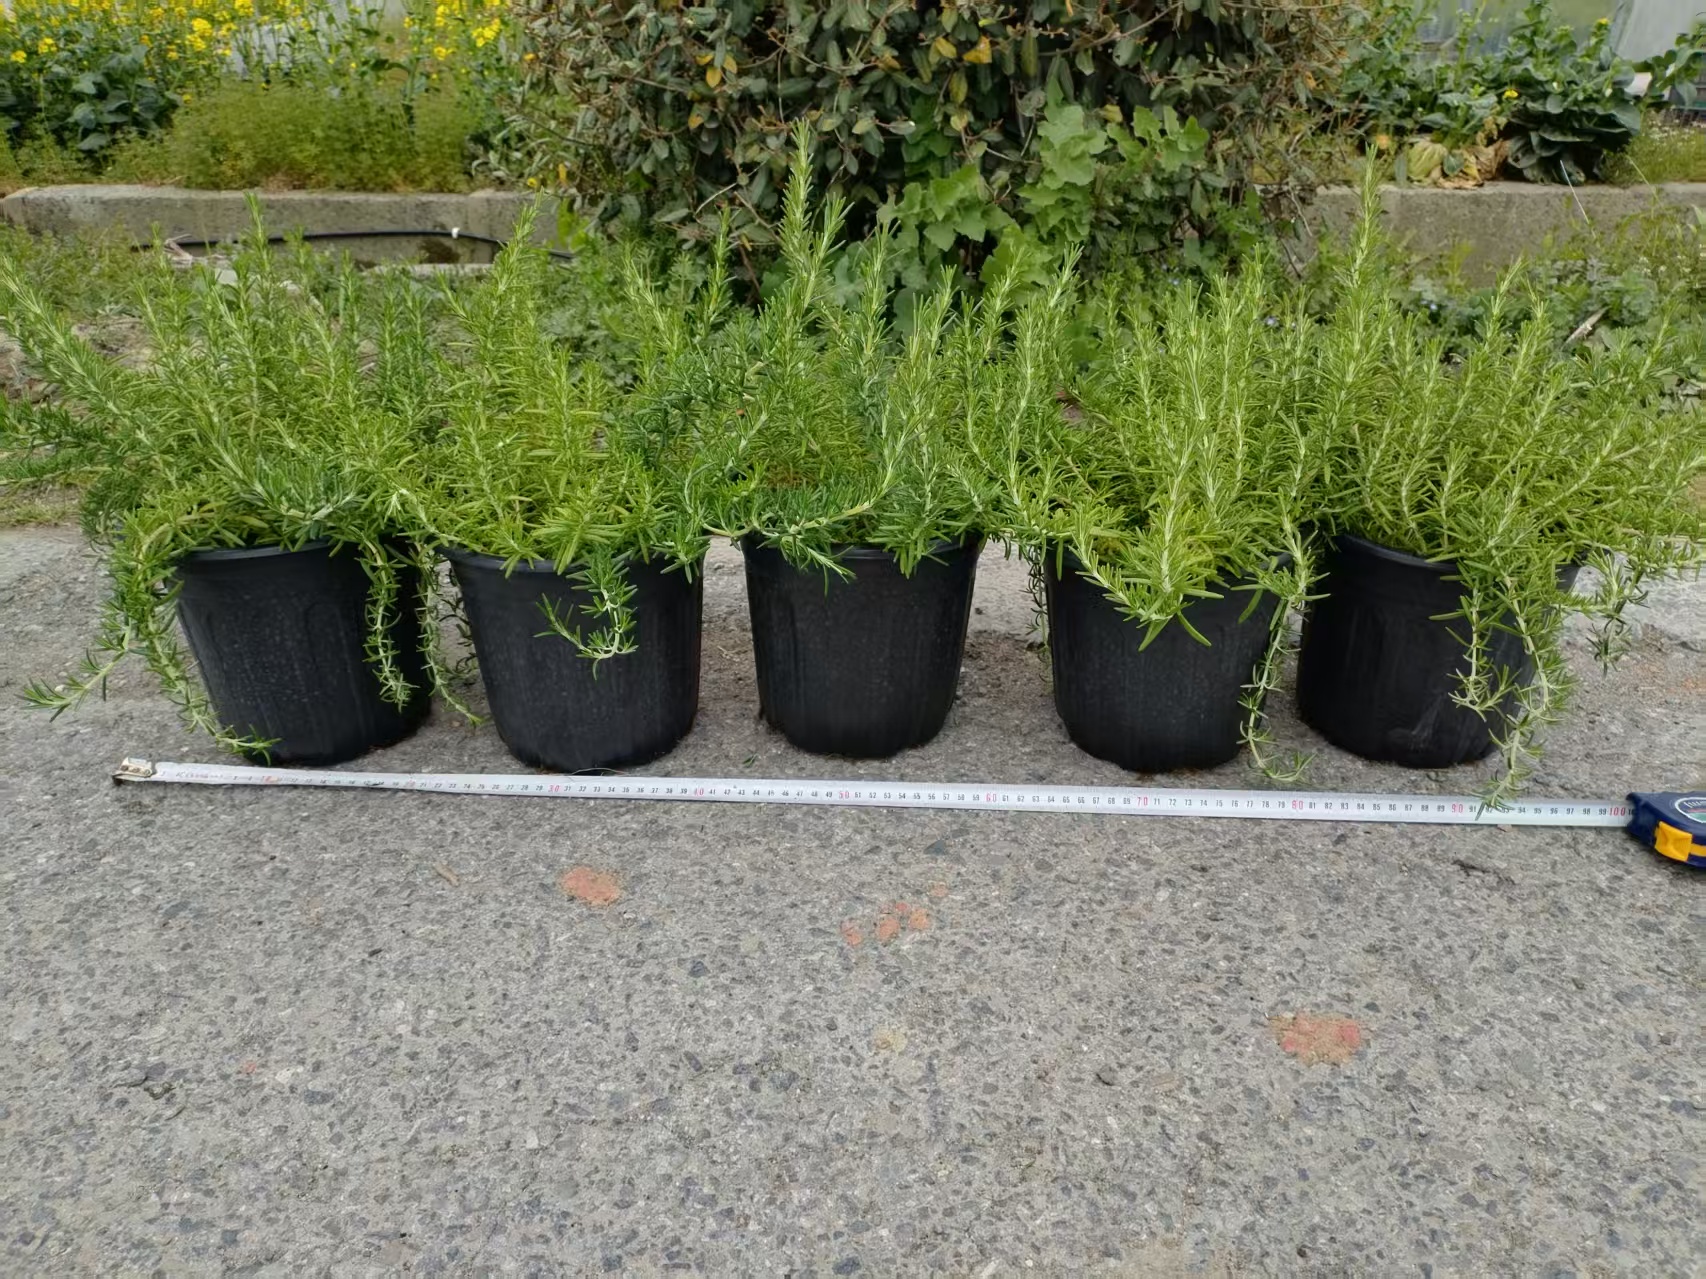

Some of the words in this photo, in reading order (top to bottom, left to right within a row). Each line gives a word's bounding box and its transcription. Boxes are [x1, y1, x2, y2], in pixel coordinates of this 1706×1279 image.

[838, 791, 850, 800] 50
[985, 794, 997, 802] 60
[1136, 798, 1148, 806] 70
[1278, 801, 1286, 809] 79
[1291, 800, 1303, 810] 80
[1308, 802, 1317, 810] 81
[1324, 802, 1333, 810] 82
[1340, 802, 1349, 810] 83
[1356, 803, 1365, 811] 84
[1372, 804, 1381, 812] 85
[1388, 804, 1397, 812] 86
[1405, 804, 1413, 812] 87
[1421, 804, 1429, 812] 88
[1437, 804, 1445, 812] 89
[1451, 804, 1463, 813] 90
[1468, 804, 1477, 812] 91
[1518, 806, 1526, 814] 94
[1534, 807, 1542, 815] 95
[1550, 807, 1558, 815] 96
[1566, 808, 1575, 816] 97
[1583, 808, 1591, 816] 98
[1598, 808, 1607, 816] 99
[1609, 807, 1625, 817] 100
